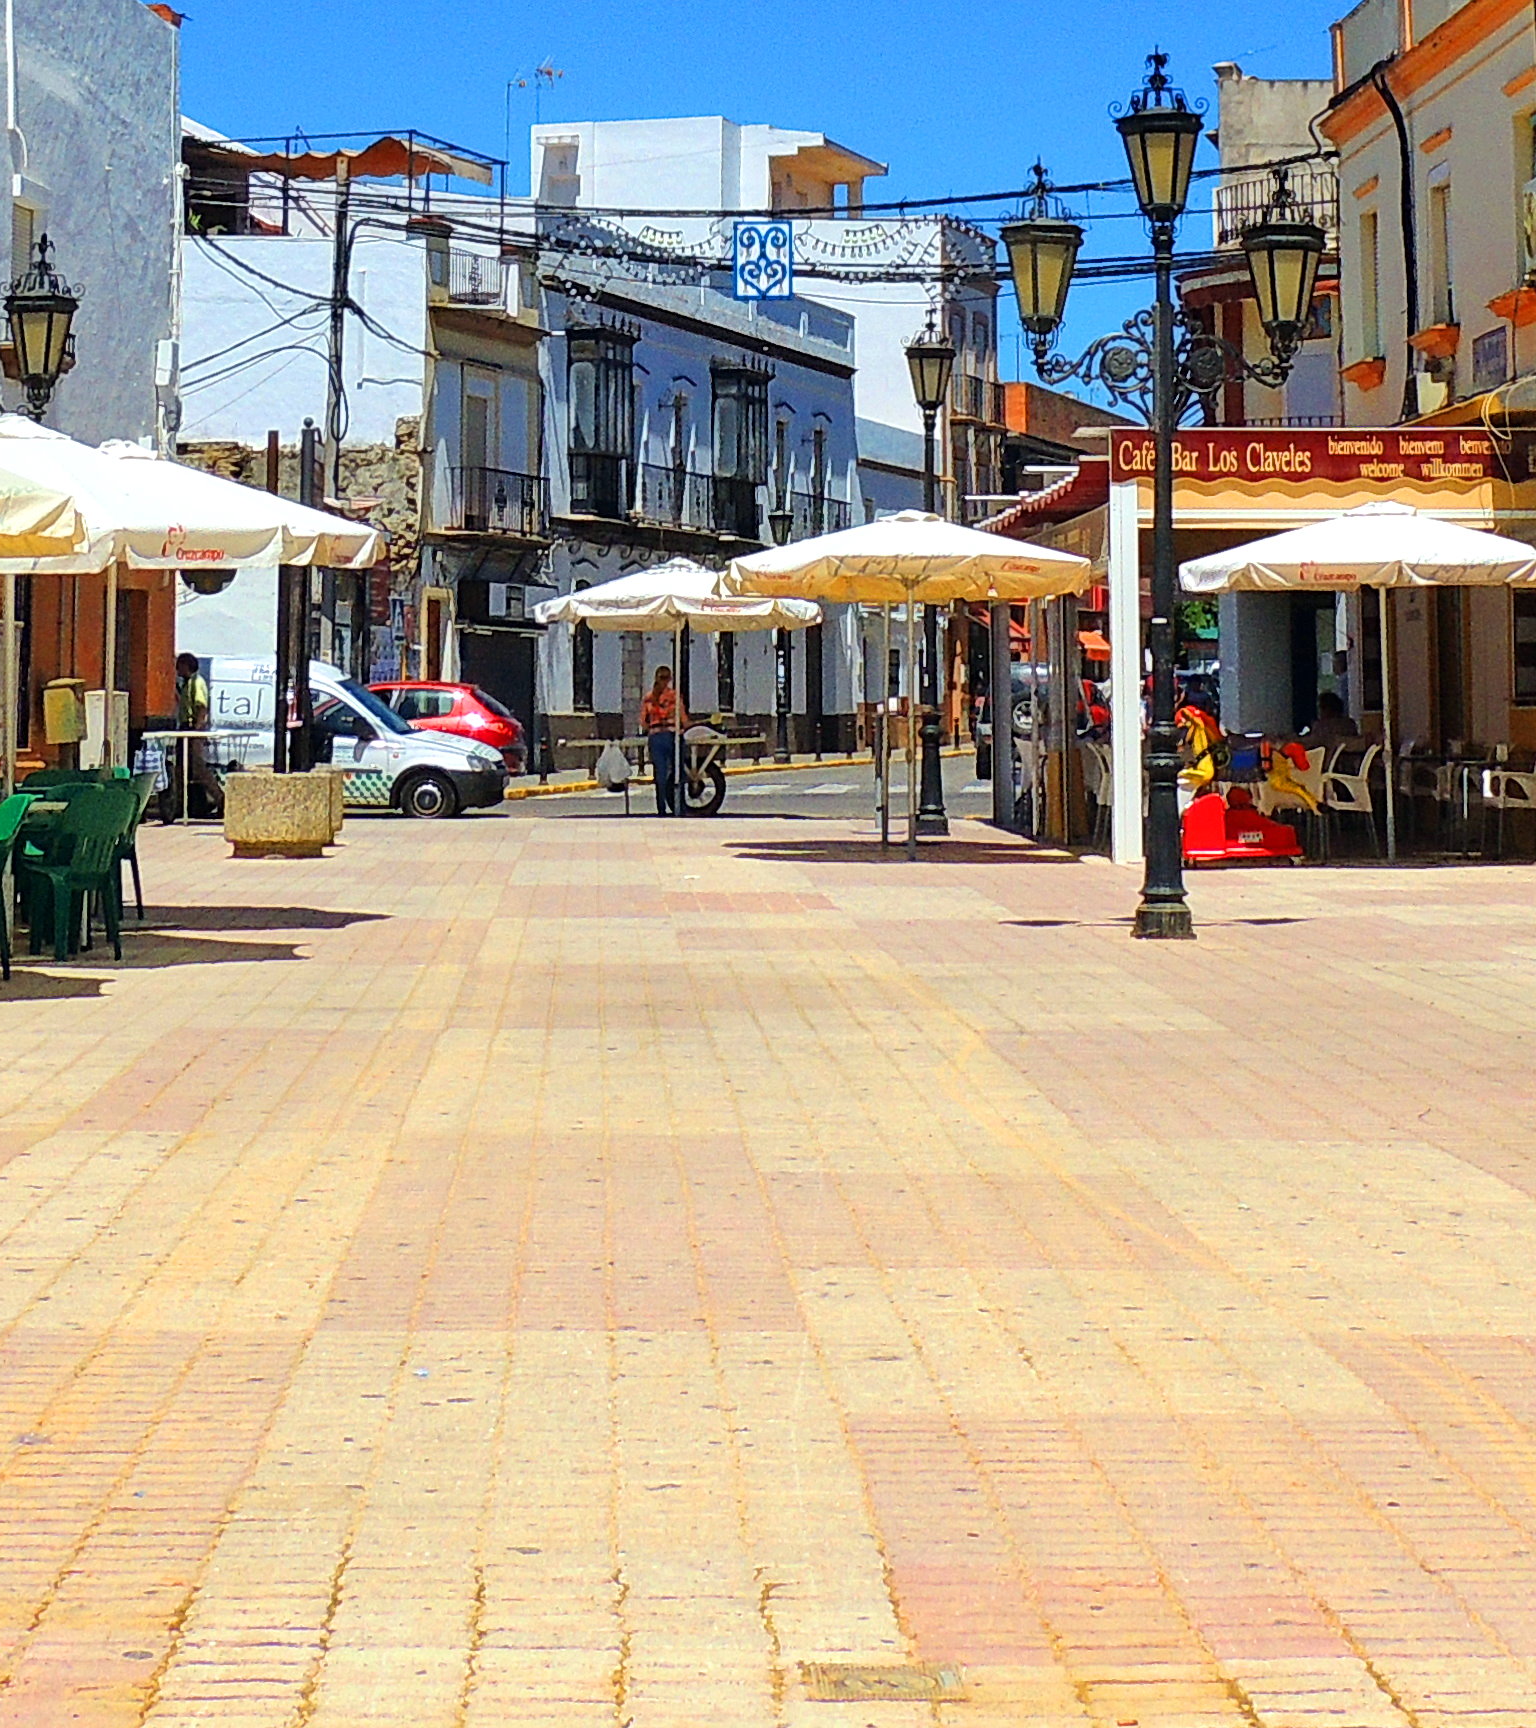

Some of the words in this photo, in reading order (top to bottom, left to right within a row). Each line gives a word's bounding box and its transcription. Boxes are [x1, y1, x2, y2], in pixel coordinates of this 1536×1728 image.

[1327, 435, 1384, 455] bienvenido
[1119, 440, 1156, 471] Café
[1170, 441, 1199, 472] Bar
[1207, 442, 1238, 472] Los
[1246, 442, 1312, 473] Claveles
[1359, 458, 1405, 478] welcome
[1420, 458, 1484, 478] willkommen
